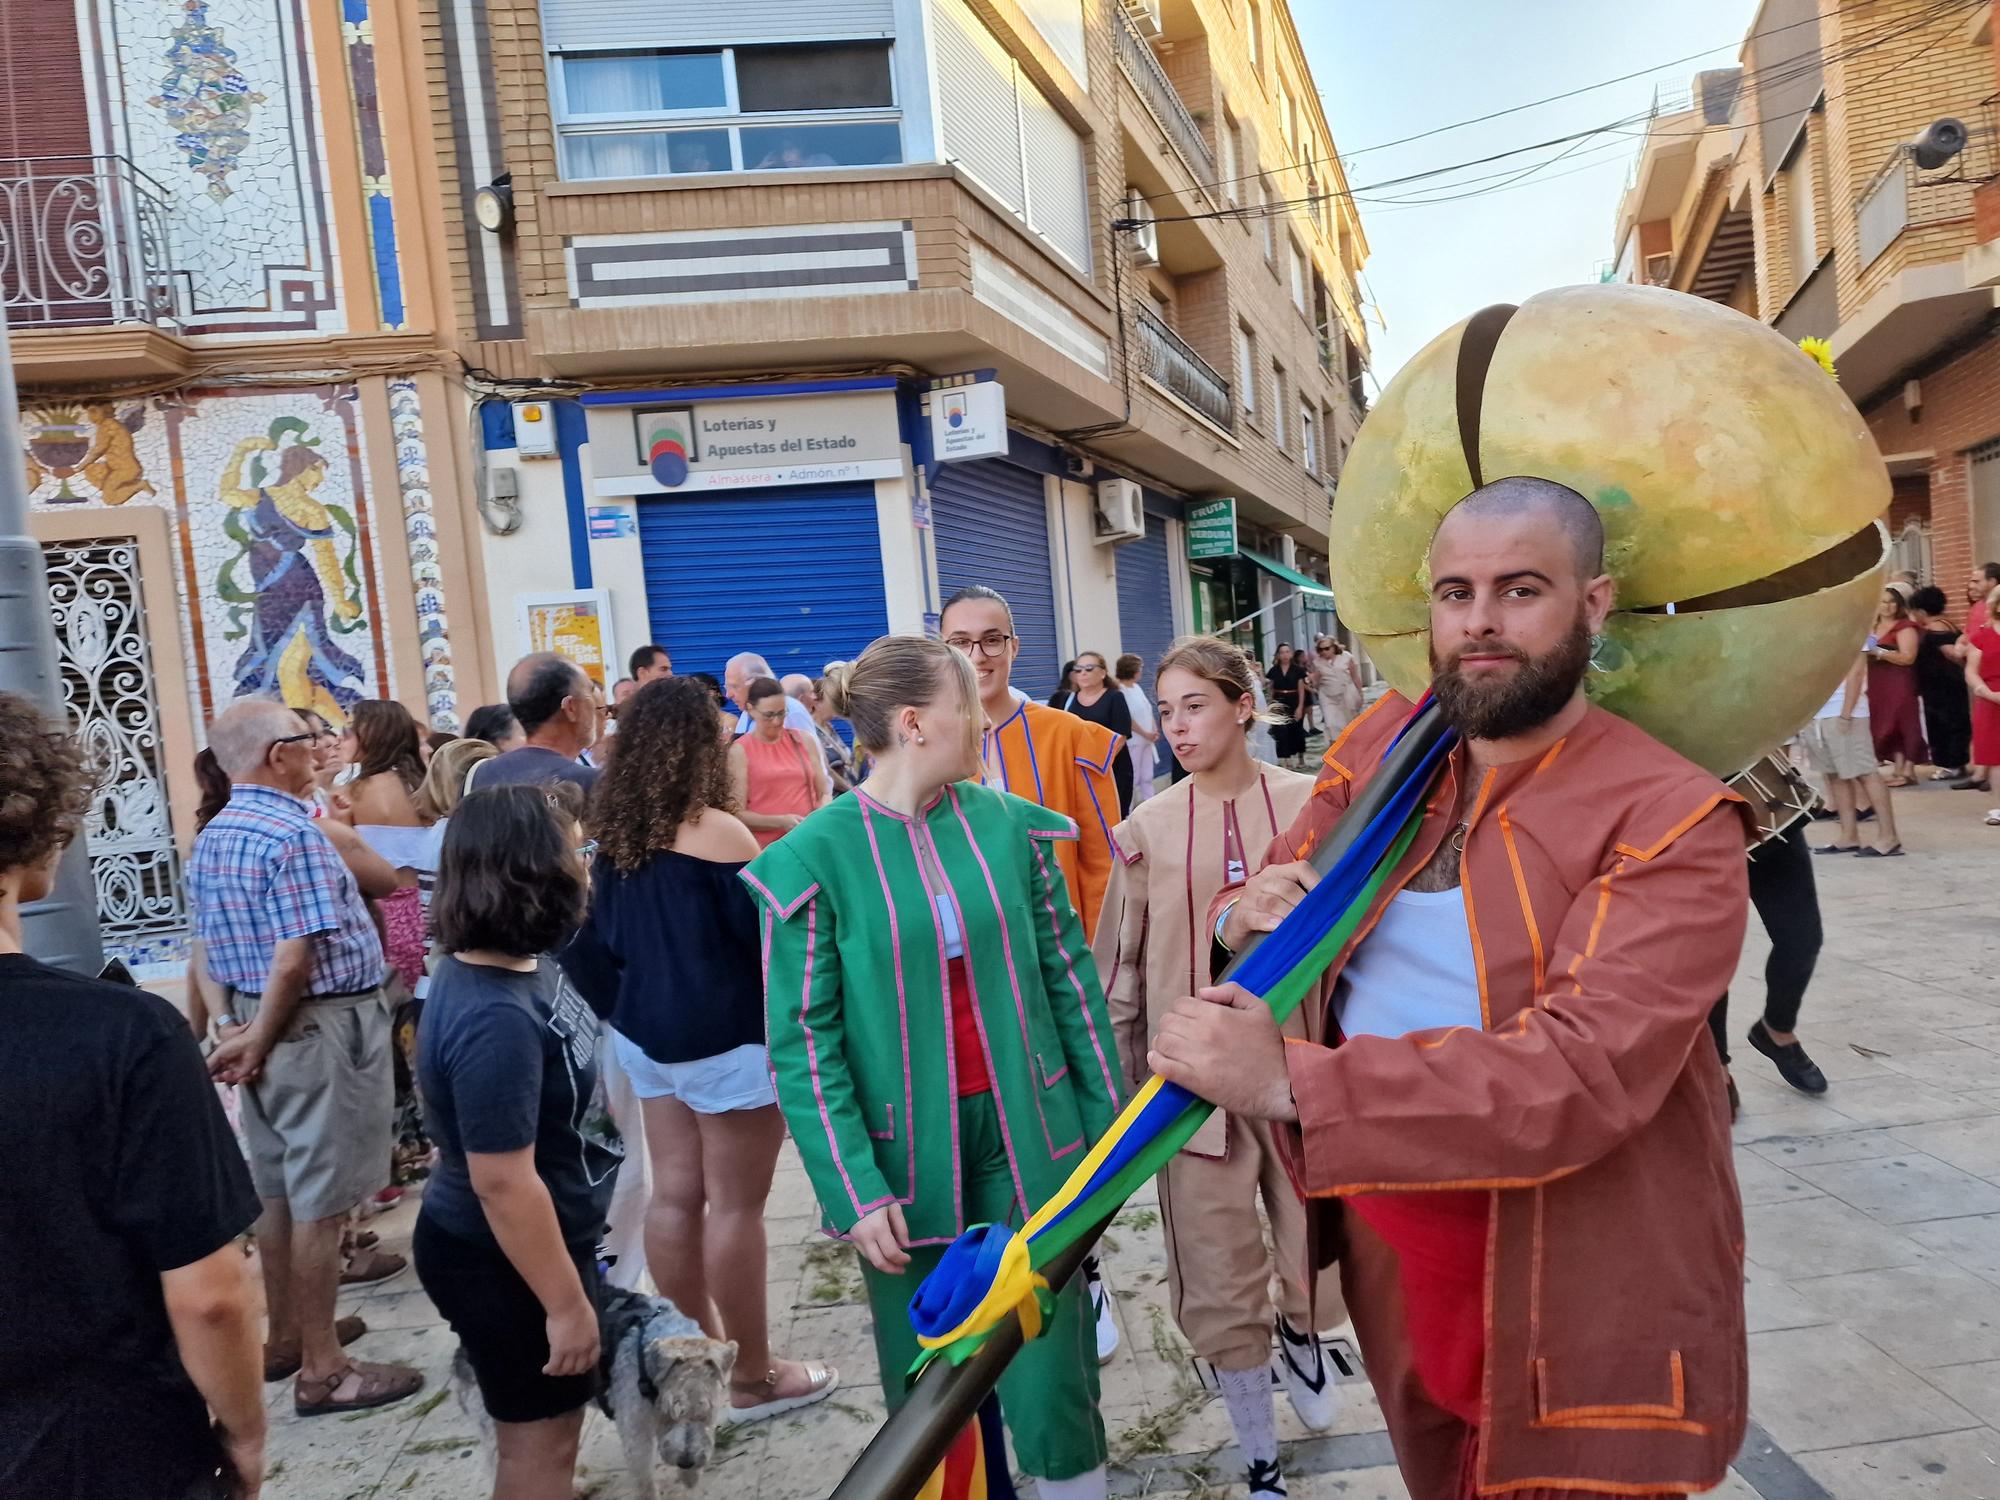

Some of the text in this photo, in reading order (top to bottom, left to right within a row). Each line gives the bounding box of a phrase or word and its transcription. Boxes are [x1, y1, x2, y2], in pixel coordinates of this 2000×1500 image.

[703, 417, 777, 432] Loterías y
[708, 435, 857, 459] Apuestas del Estado
[855, 465, 861, 476] 1
[1191, 501, 1228, 519] FRUTA
[1190, 530, 1232, 539] VERDURA
[575, 655, 601, 664] BRE
